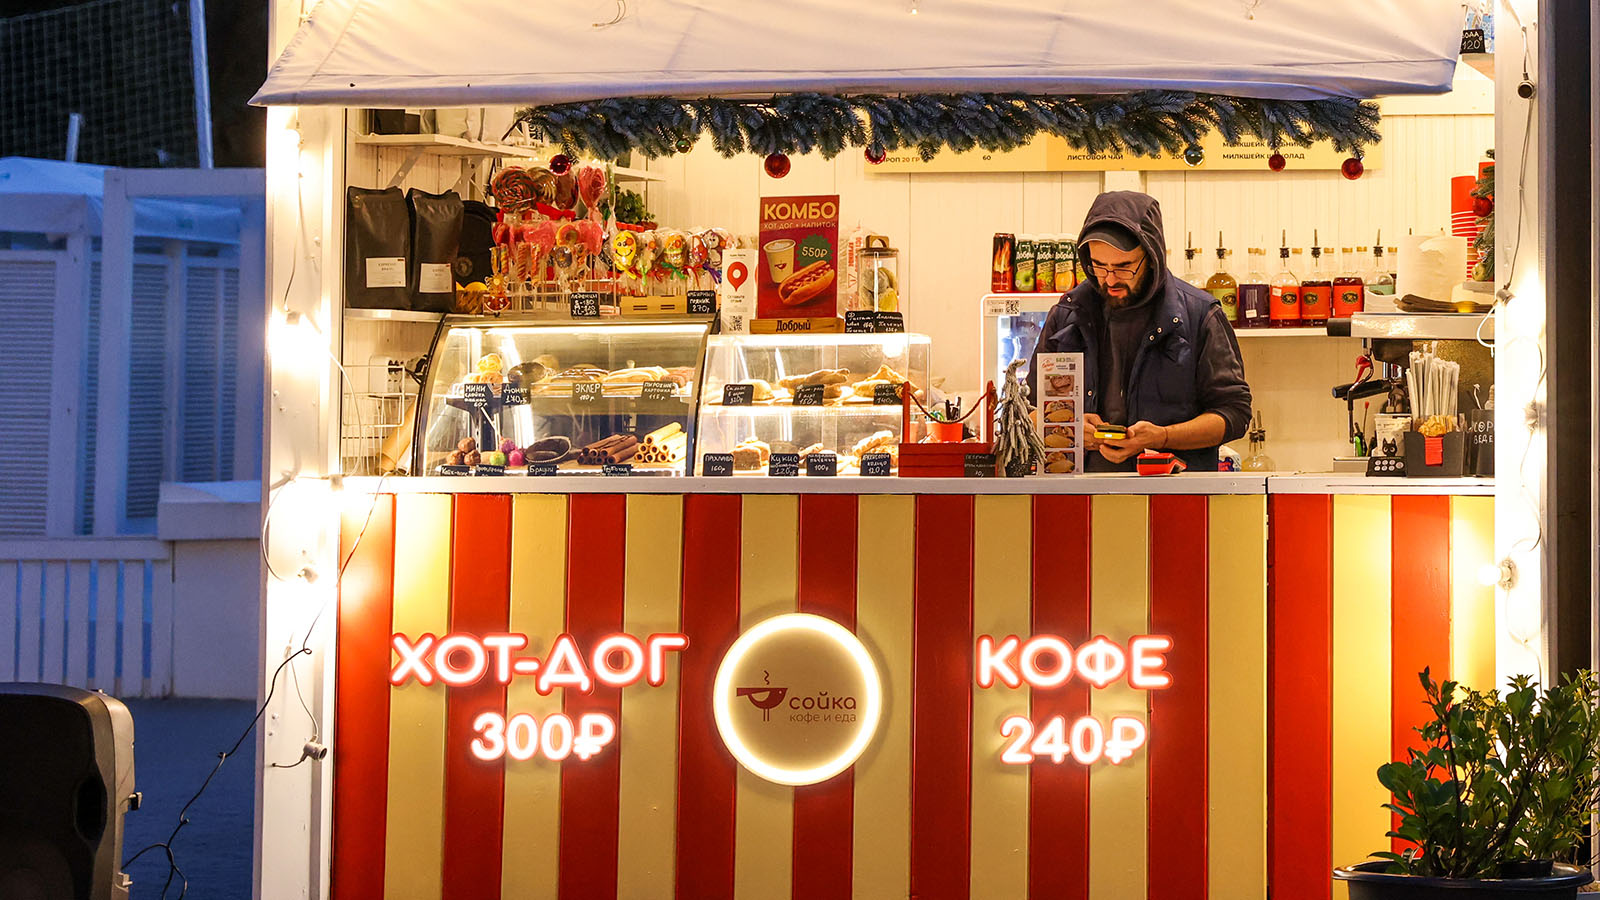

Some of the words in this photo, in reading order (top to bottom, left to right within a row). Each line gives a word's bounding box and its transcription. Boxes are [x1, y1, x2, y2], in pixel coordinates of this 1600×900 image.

[982, 154, 992, 162] 60
[1066, 153, 1107, 161] ЛИСТОВОЙ
[1107, 153, 1124, 161] ЧАЙ
[1222, 152, 1265, 160] МИЛКШЕЙК
[764, 201, 837, 220] КОМБО
[763, 222, 777, 230] ХОТ
[778, 221, 794, 230] ДОГ
[800, 221, 837, 229] НАПИТОК
[776, 319, 812, 333] Добрый
[465, 384, 486, 393] МИНИ
[575, 383, 601, 394] ЭКЛЕР
[391, 633, 689, 695] ХОТ-ДОГ
[976, 634, 1173, 689] КОФЕ
[788, 691, 857, 710] сойка
[789, 711, 821, 723] кофе
[823, 712, 832, 721] и
[834, 712, 857, 723] еда
[470, 711, 616, 762] 300₽
[1000, 715, 1147, 765] 240₽
